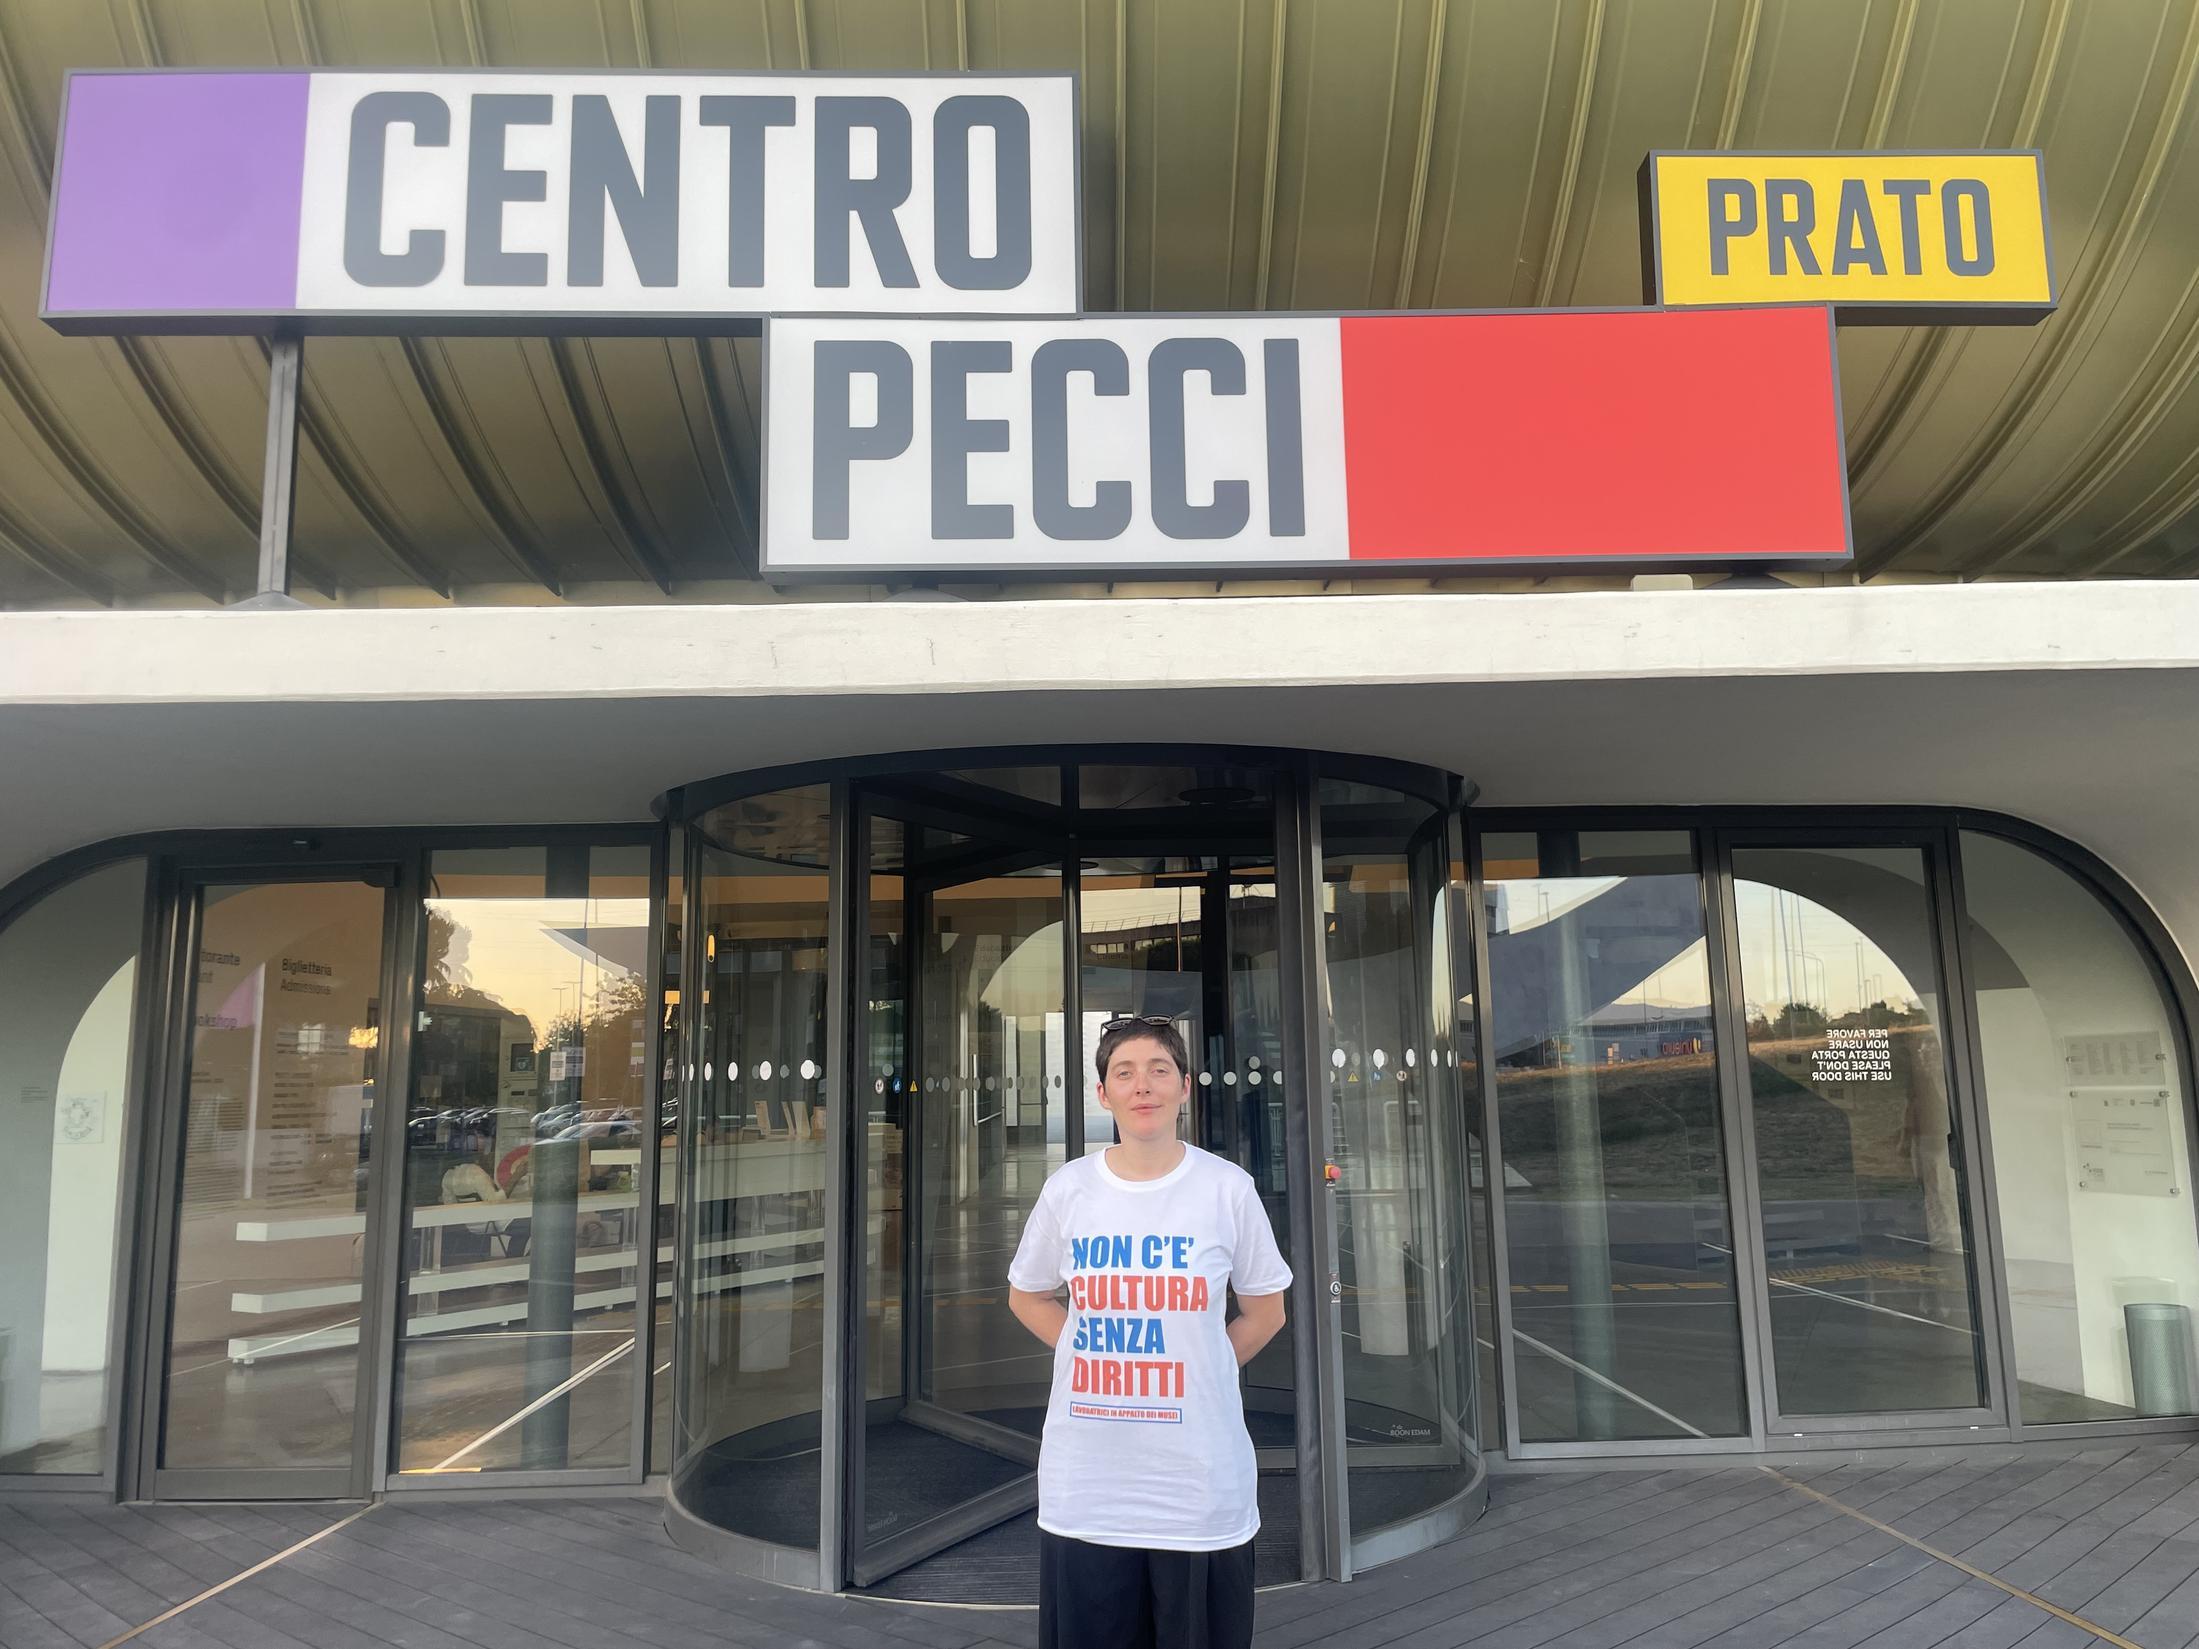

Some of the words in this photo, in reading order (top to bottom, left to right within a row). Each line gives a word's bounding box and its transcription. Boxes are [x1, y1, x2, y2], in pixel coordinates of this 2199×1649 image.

[343, 90, 1033, 291] CENTRO
[1707, 178, 1995, 277] PRATO
[812, 337, 1306, 541] PECCI
[281, 958, 333, 977] Biglietteria
[1071, 1235, 1132, 1270] NON
[1070, 1275, 1209, 1312] CULTURA
[1072, 1315, 1165, 1354] SENZA
[1072, 1356, 1185, 1398] DIRITTI
[1118, 1410, 1145, 1418] APPALTO
[1146, 1410, 1157, 1419] DEI
[1157, 1411, 1178, 1419] MUSEI
